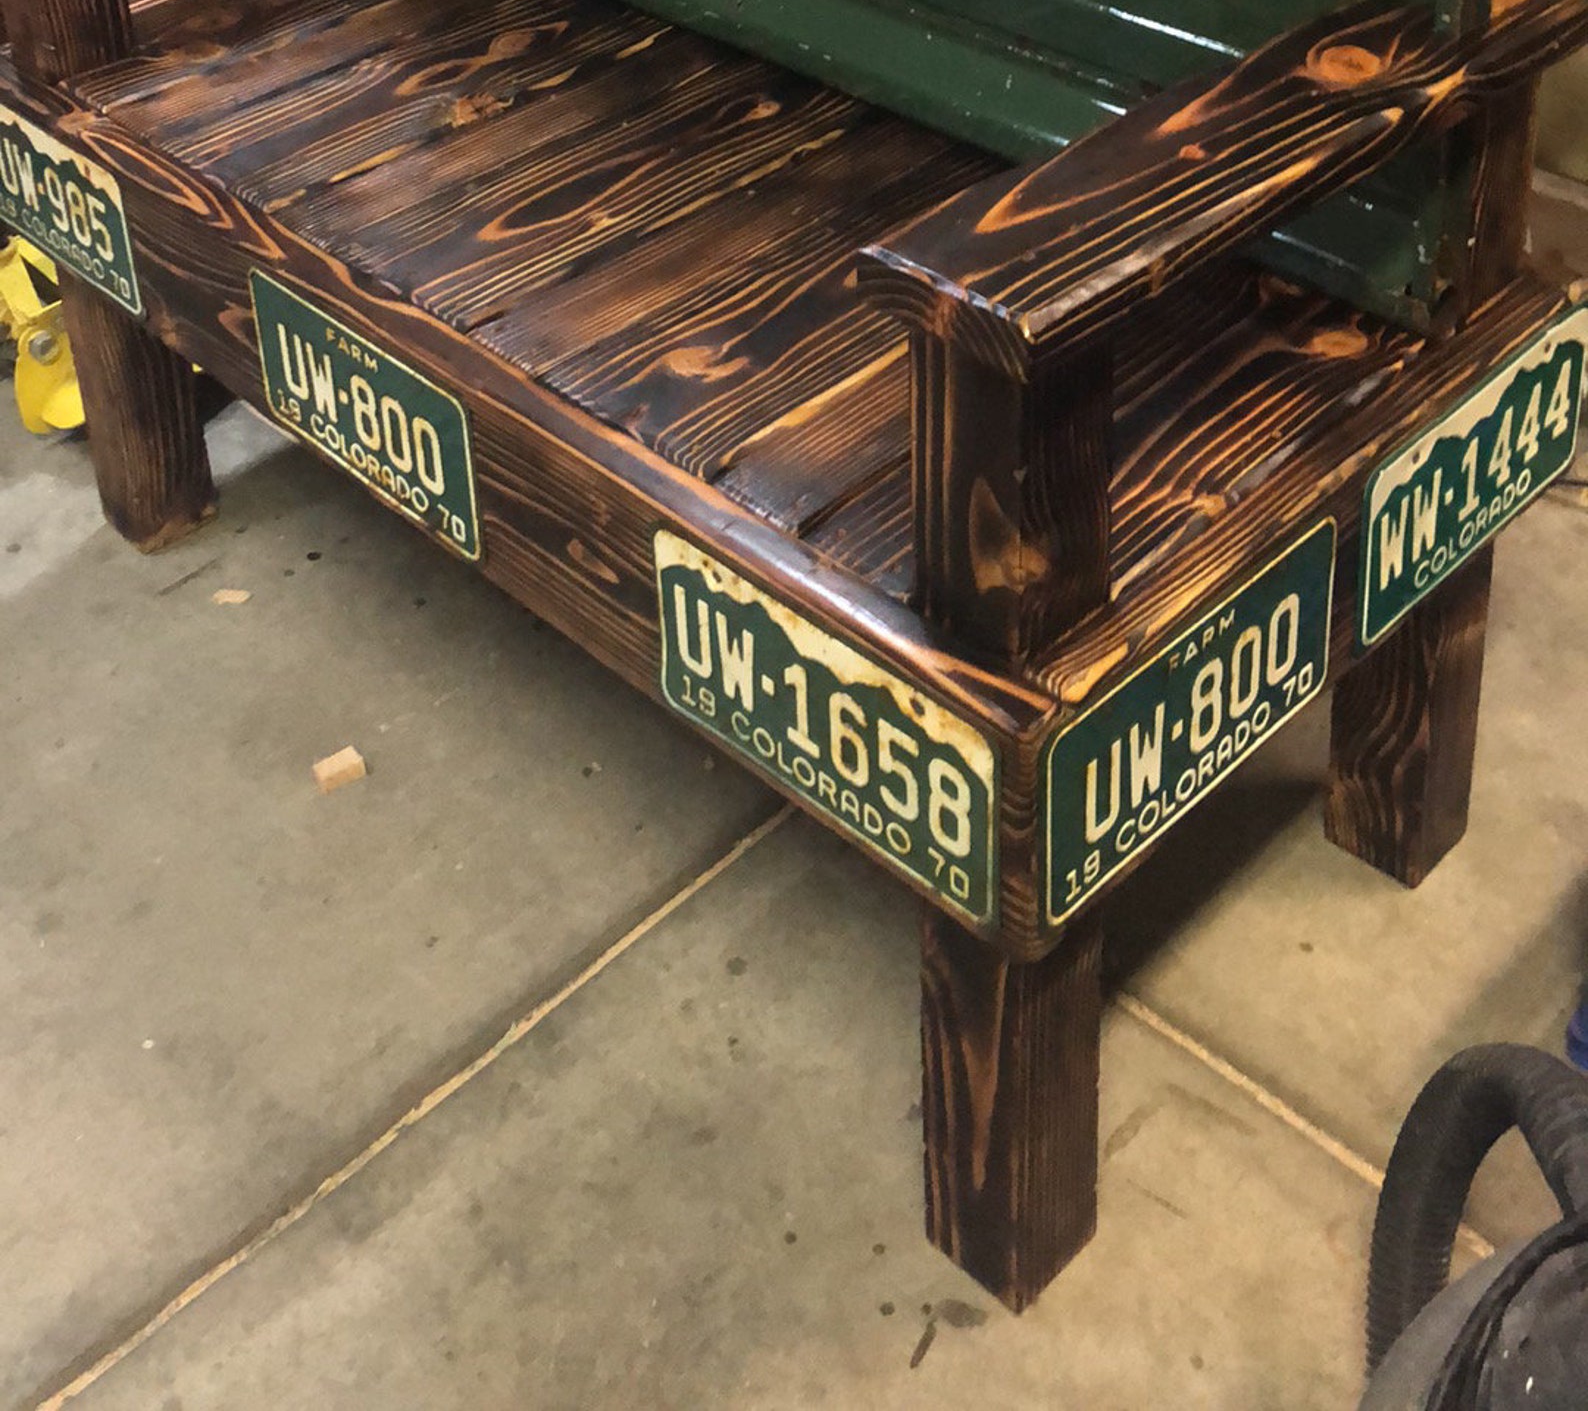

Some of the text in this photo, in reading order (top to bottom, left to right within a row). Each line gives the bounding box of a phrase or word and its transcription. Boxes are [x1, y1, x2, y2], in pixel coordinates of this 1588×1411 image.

[22, 209, 105, 280] COLORADO
[277, 323, 445, 496] UW-800
[325, 327, 379, 373] FARM
[310, 414, 429, 513] COLORADO
[437, 504, 467, 544] 70
[1413, 468, 1532, 589] COLORADO
[1168, 608, 1236, 671] FARM
[674, 584, 972, 858] UW-1658
[1065, 661, 1314, 904] 19 COLORADO 70
[1085, 592, 1300, 845] UW-800
[731, 710, 912, 855] COLORADO
[927, 846, 970, 901] 70
